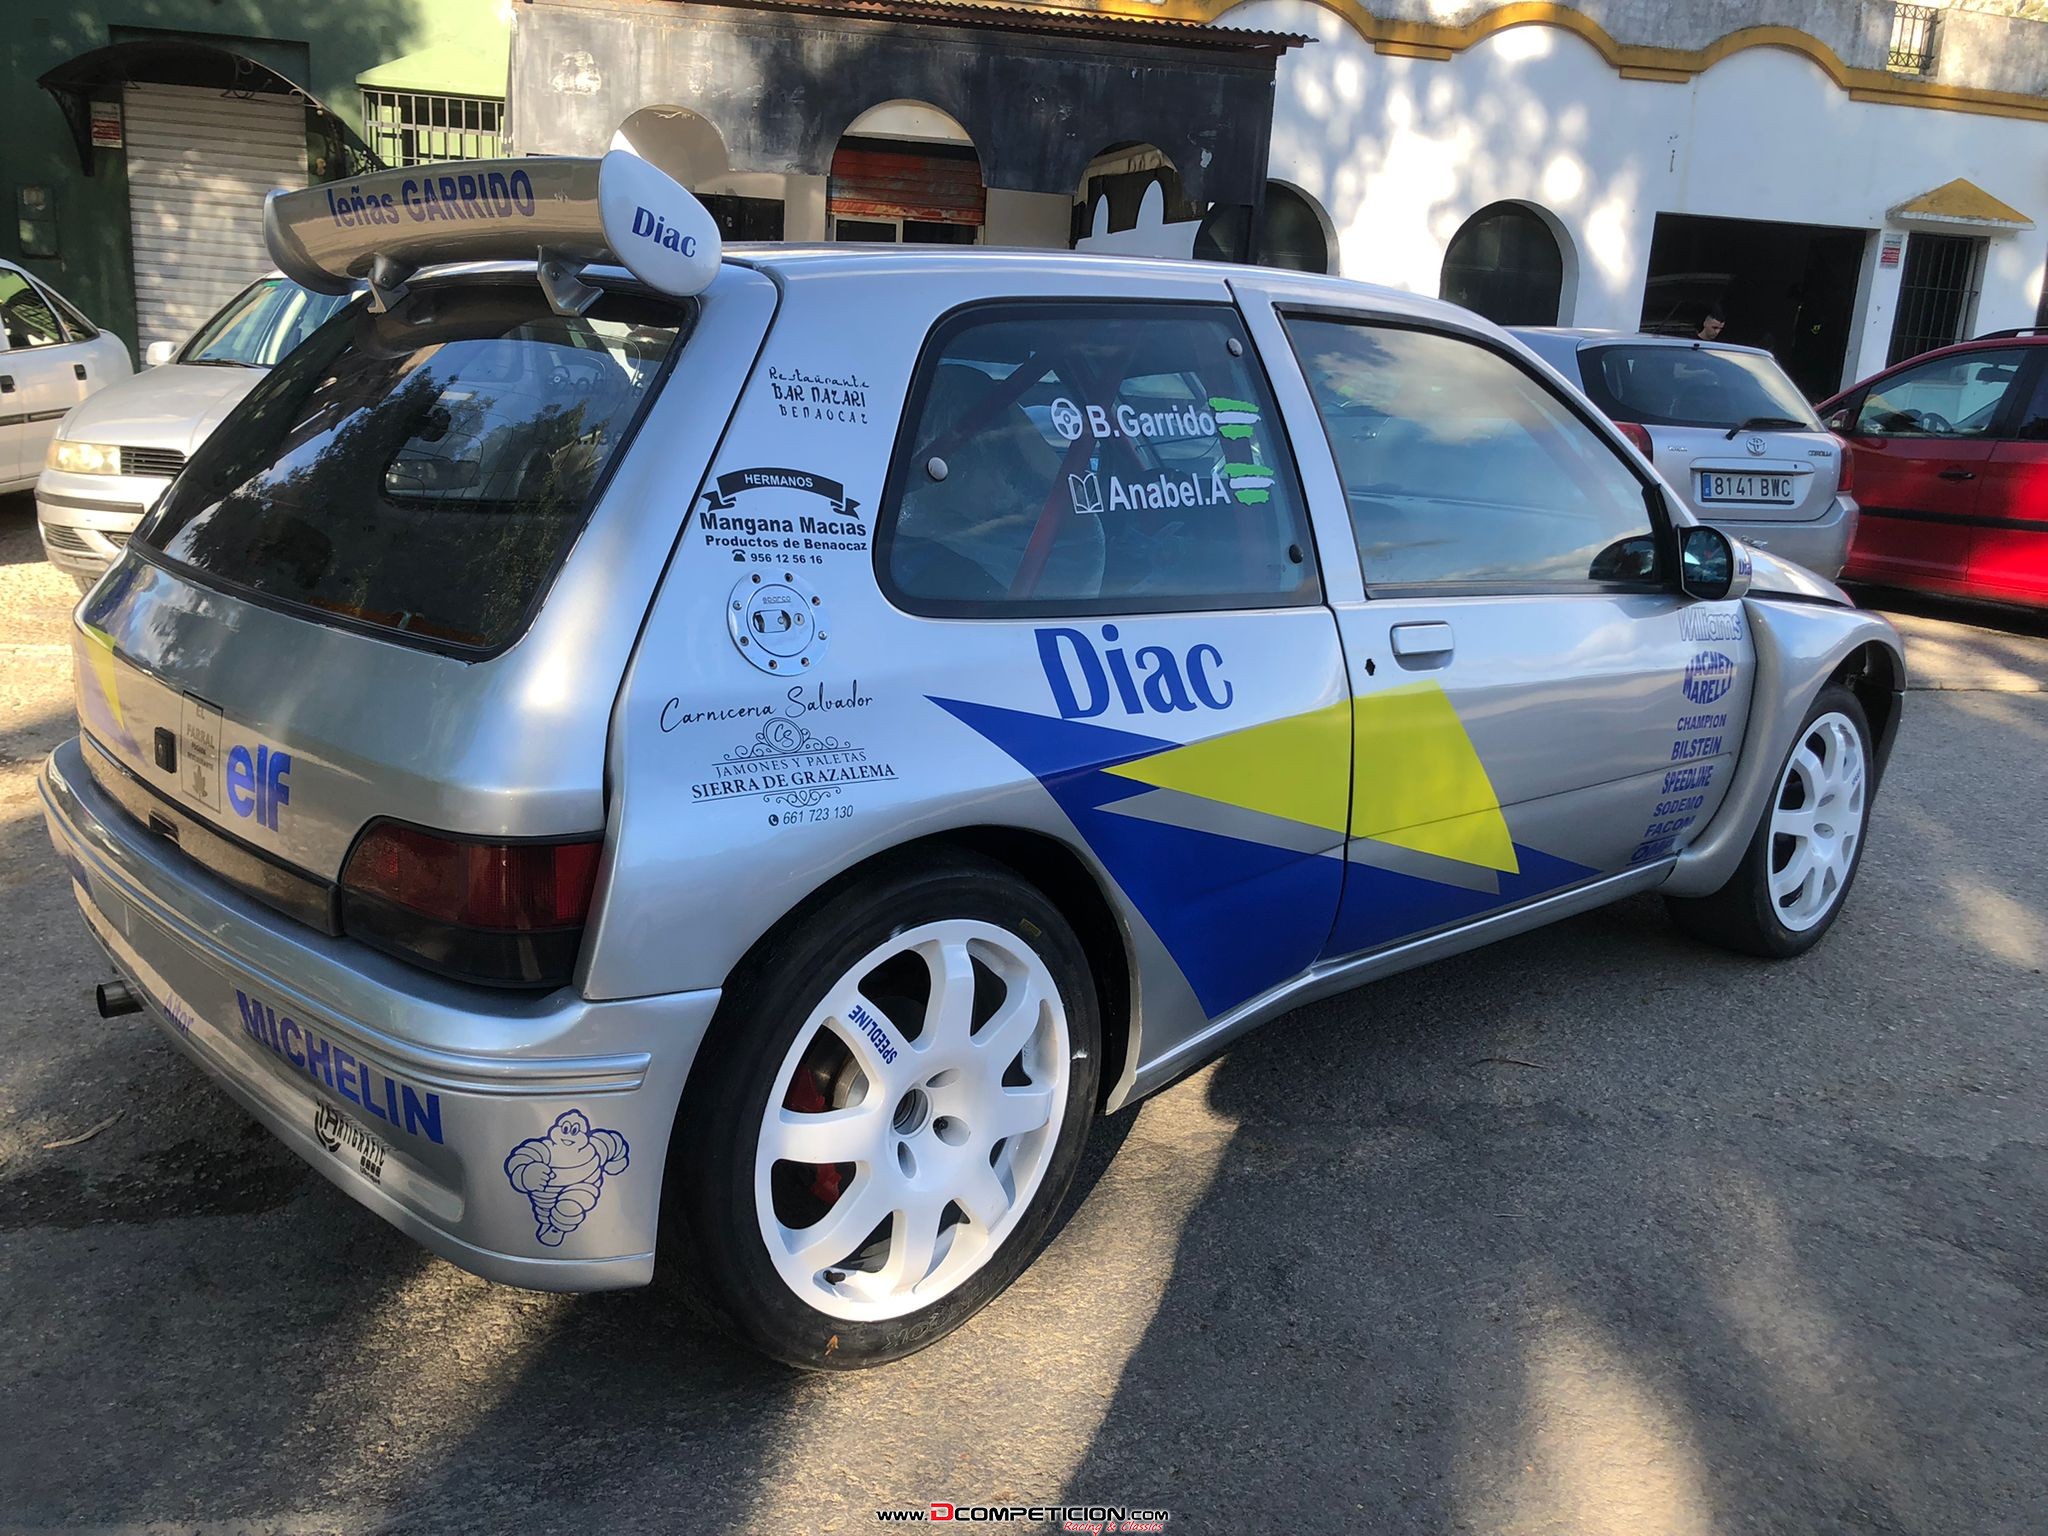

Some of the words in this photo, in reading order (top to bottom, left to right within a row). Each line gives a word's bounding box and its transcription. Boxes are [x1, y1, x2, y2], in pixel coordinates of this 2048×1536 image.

[327, 185, 399, 228] leñas
[401, 169, 536, 223] GARRIDO
[632, 206, 697, 258] Diac
[771, 383, 805, 402] BAR
[811, 386, 866, 407] NAZARI
[779, 404, 868, 424] BENAOCAZ
[1085, 404, 1217, 438] B.Garrido
[744, 474, 814, 487] HERMANOS
[1109, 472, 1231, 511] Anabel.A
[1714, 477, 1753, 495] 8141
[1761, 478, 1790, 497] BWC
[700, 512, 793, 535] Mangana
[705, 535, 778, 548] Productos
[783, 538, 800, 548] de
[804, 538, 867, 551] Benaocaz
[751, 553, 772, 563] 956
[776, 554, 789, 563] 12
[793, 554, 806, 564] 56
[810, 555, 823, 565] 16
[1034, 623, 1234, 719] Diac
[785, 679, 873, 718] Salvador
[1682, 677, 1733, 704] MARELLI
[1677, 714, 1727, 731] CHAMPION
[1671, 736, 1722, 760] BILSTEIN
[716, 758, 789, 778] JAMONES
[791, 757, 802, 768] Y
[807, 751, 867, 767] PALETAS
[226, 743, 292, 832] elf
[691, 777, 760, 799] SIERRA
[763, 774, 786, 790] DE
[791, 763, 896, 786] GRAZALEMA
[1662, 765, 1714, 795] SPEEDLINE
[783, 811, 804, 825] 661
[809, 808, 830, 823] 723
[834, 804, 854, 819] 130
[1653, 795, 1704, 817] SODEMO
[1644, 815, 1696, 838] FACOM
[848, 1004, 898, 1065] SPEEDLINE
[236, 989, 444, 1145] MICHELIN
